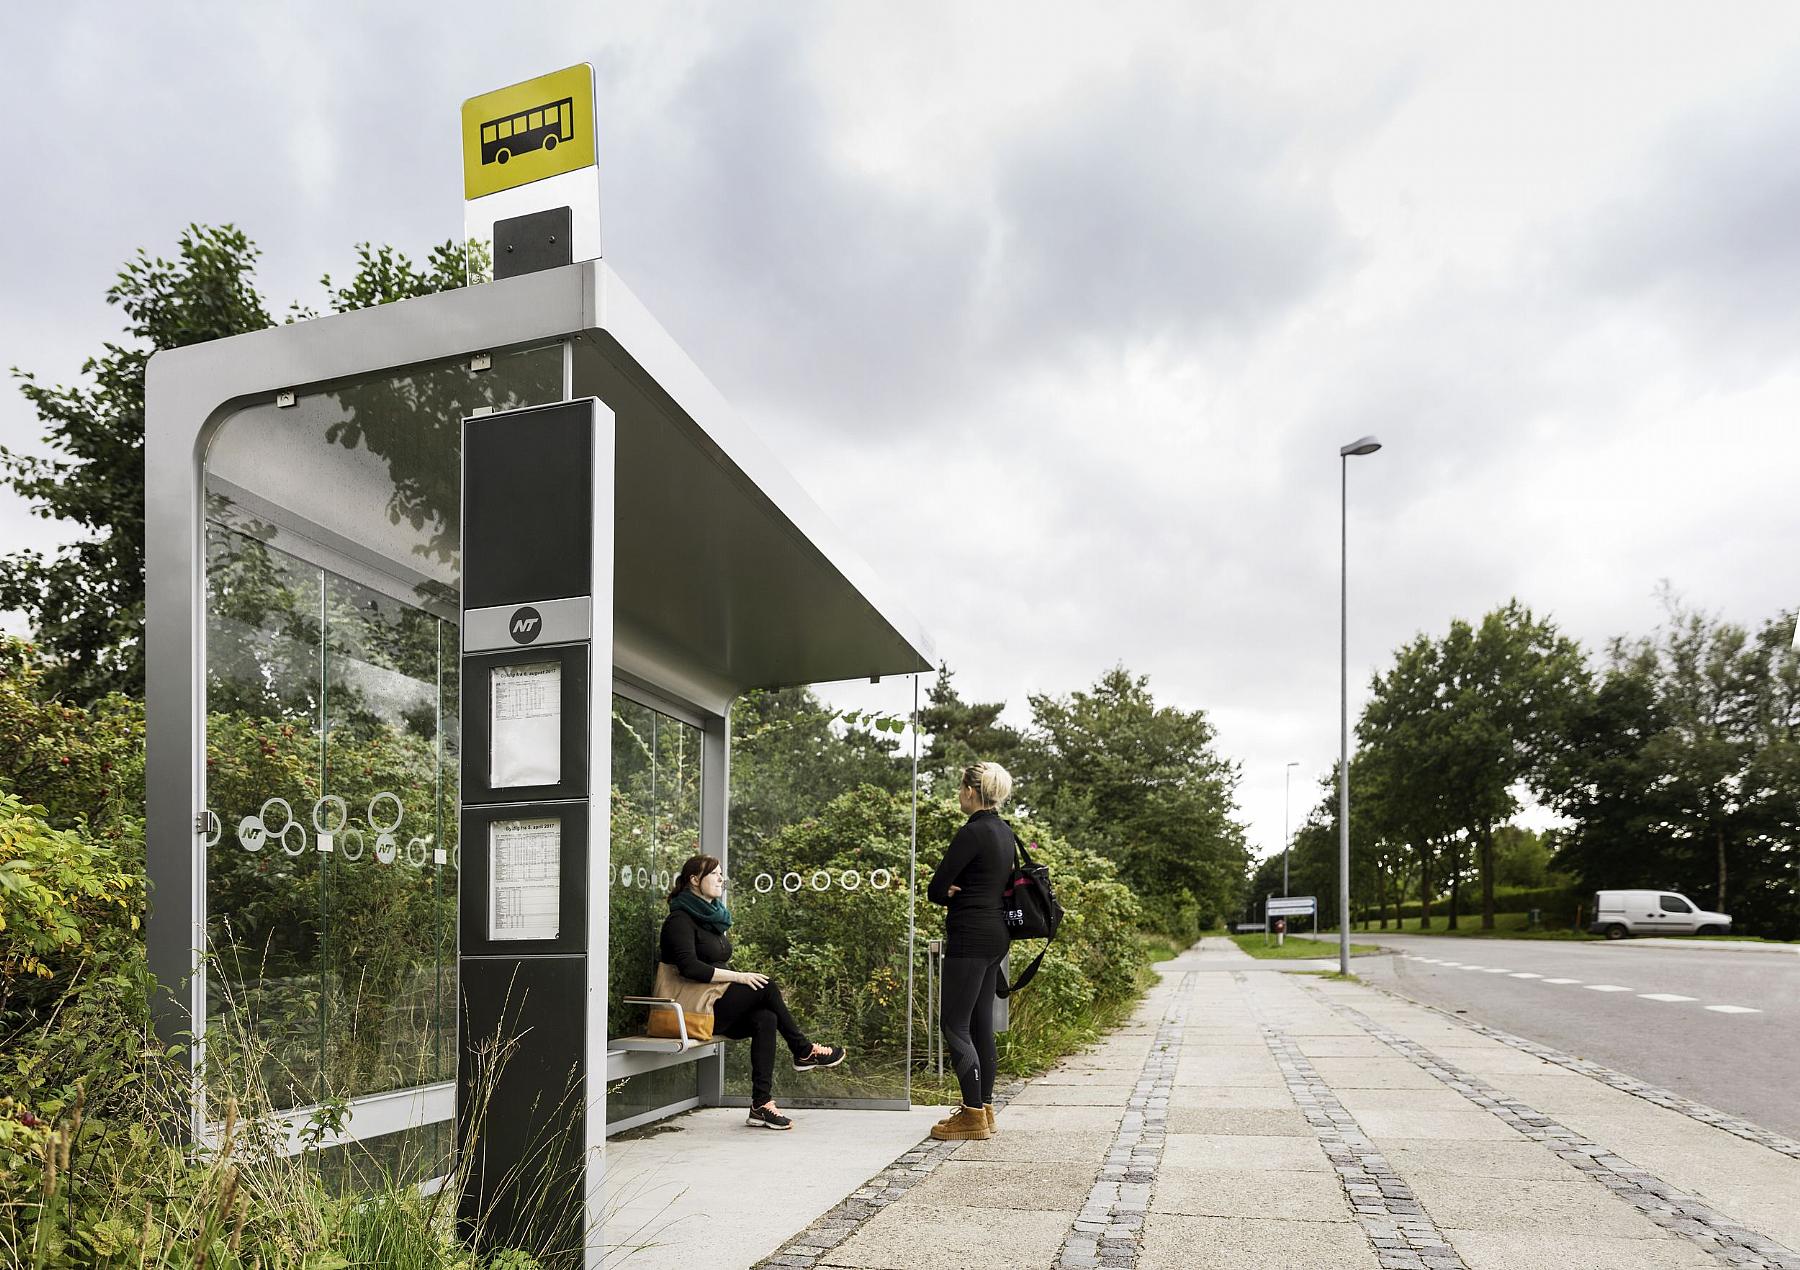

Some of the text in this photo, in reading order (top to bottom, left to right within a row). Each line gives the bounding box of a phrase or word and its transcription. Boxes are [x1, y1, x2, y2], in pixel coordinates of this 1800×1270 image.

[513, 618, 539, 633] NT
[241, 827, 262, 839] NT
[378, 843, 394, 853] NT
